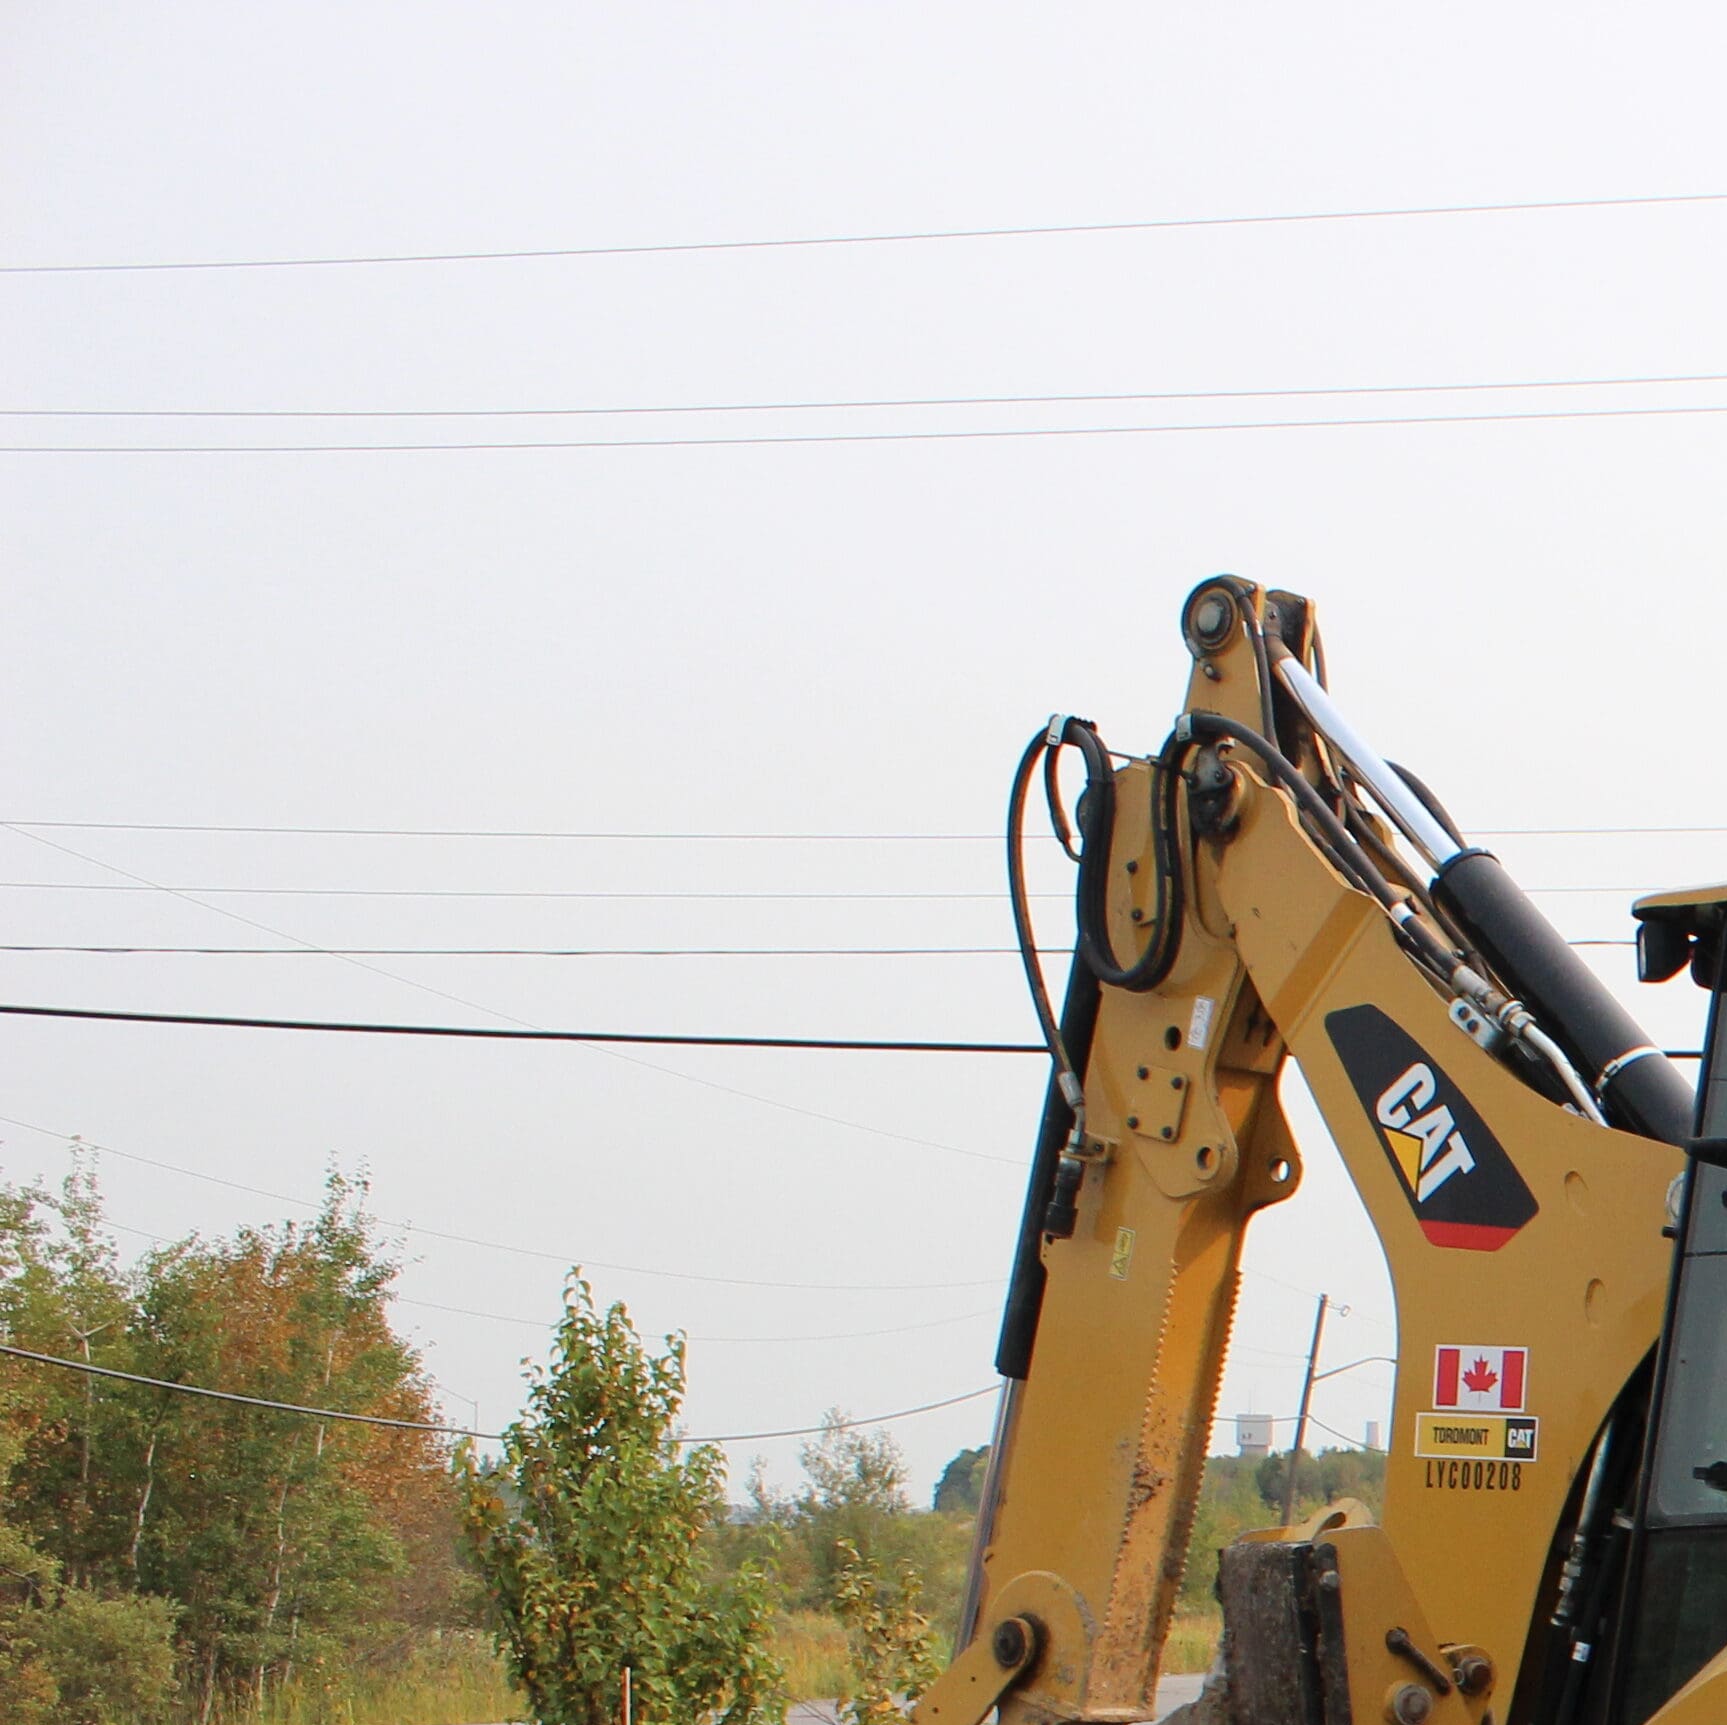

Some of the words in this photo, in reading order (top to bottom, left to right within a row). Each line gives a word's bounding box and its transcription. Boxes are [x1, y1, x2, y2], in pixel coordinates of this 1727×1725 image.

[1376, 1062, 1476, 1203] CAT
[1433, 1427, 1489, 1445] TOROMONT
[1507, 1428, 1534, 1449] CAT
[1426, 1460, 1521, 1491] LYC00208
